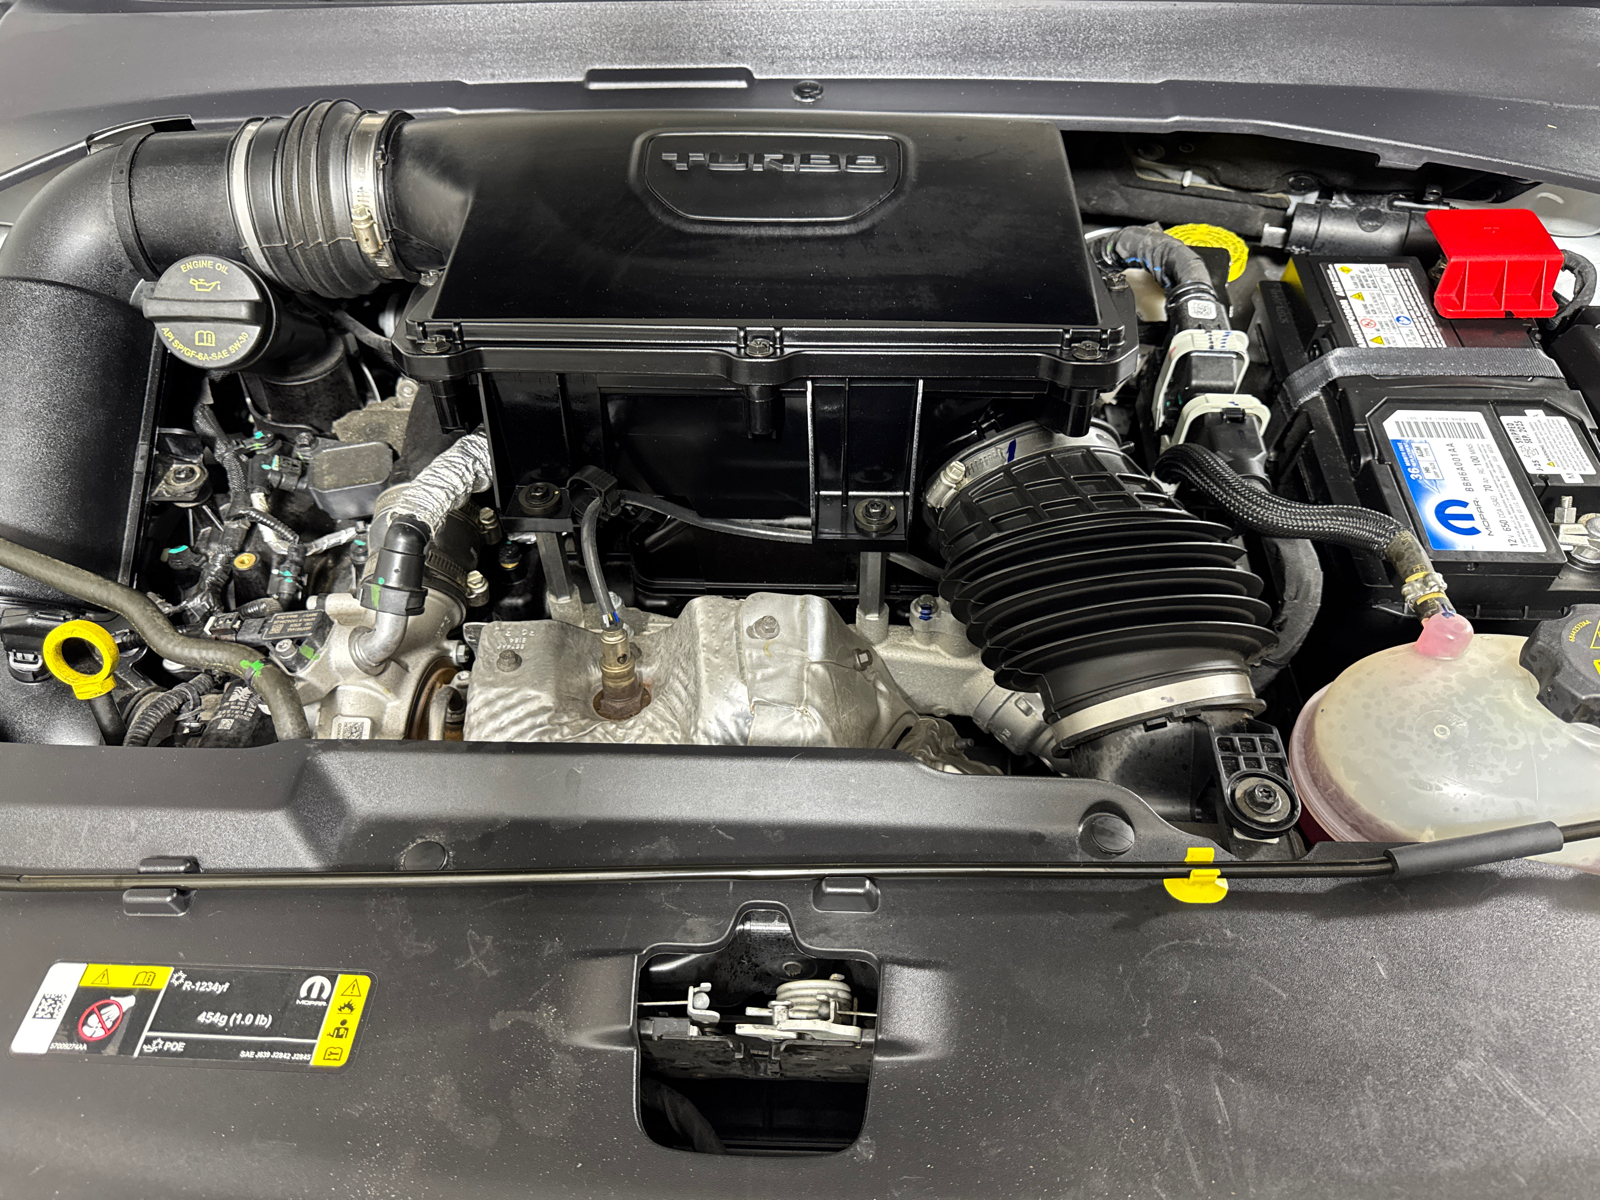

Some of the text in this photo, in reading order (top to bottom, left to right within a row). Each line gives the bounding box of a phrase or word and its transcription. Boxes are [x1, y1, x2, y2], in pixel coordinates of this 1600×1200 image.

[660, 152, 888, 173] TURBO
[180, 260, 229, 275] ENGINE OIL
[161, 327, 249, 361] API SP/GF-6A-SAE 5W-30
[1506, 423, 1524, 443] SHIPPED
[1514, 421, 1527, 433] 2025
[1414, 446, 1425, 458] AGM
[1445, 443, 1474, 492] BBH6A001AA
[1470, 456, 1481, 466] 100
[1407, 467, 1423, 480] 36
[1483, 484, 1494, 492] 70
[1473, 499, 1494, 536] MOPAR
[1499, 519, 1512, 532] 650
[182, 981, 230, 994] R-1234yf
[197, 1011, 272, 1028] 454g (1.0 lb)
[163, 1041, 186, 1052] POE
[240, 1050, 255, 1058] SAE
